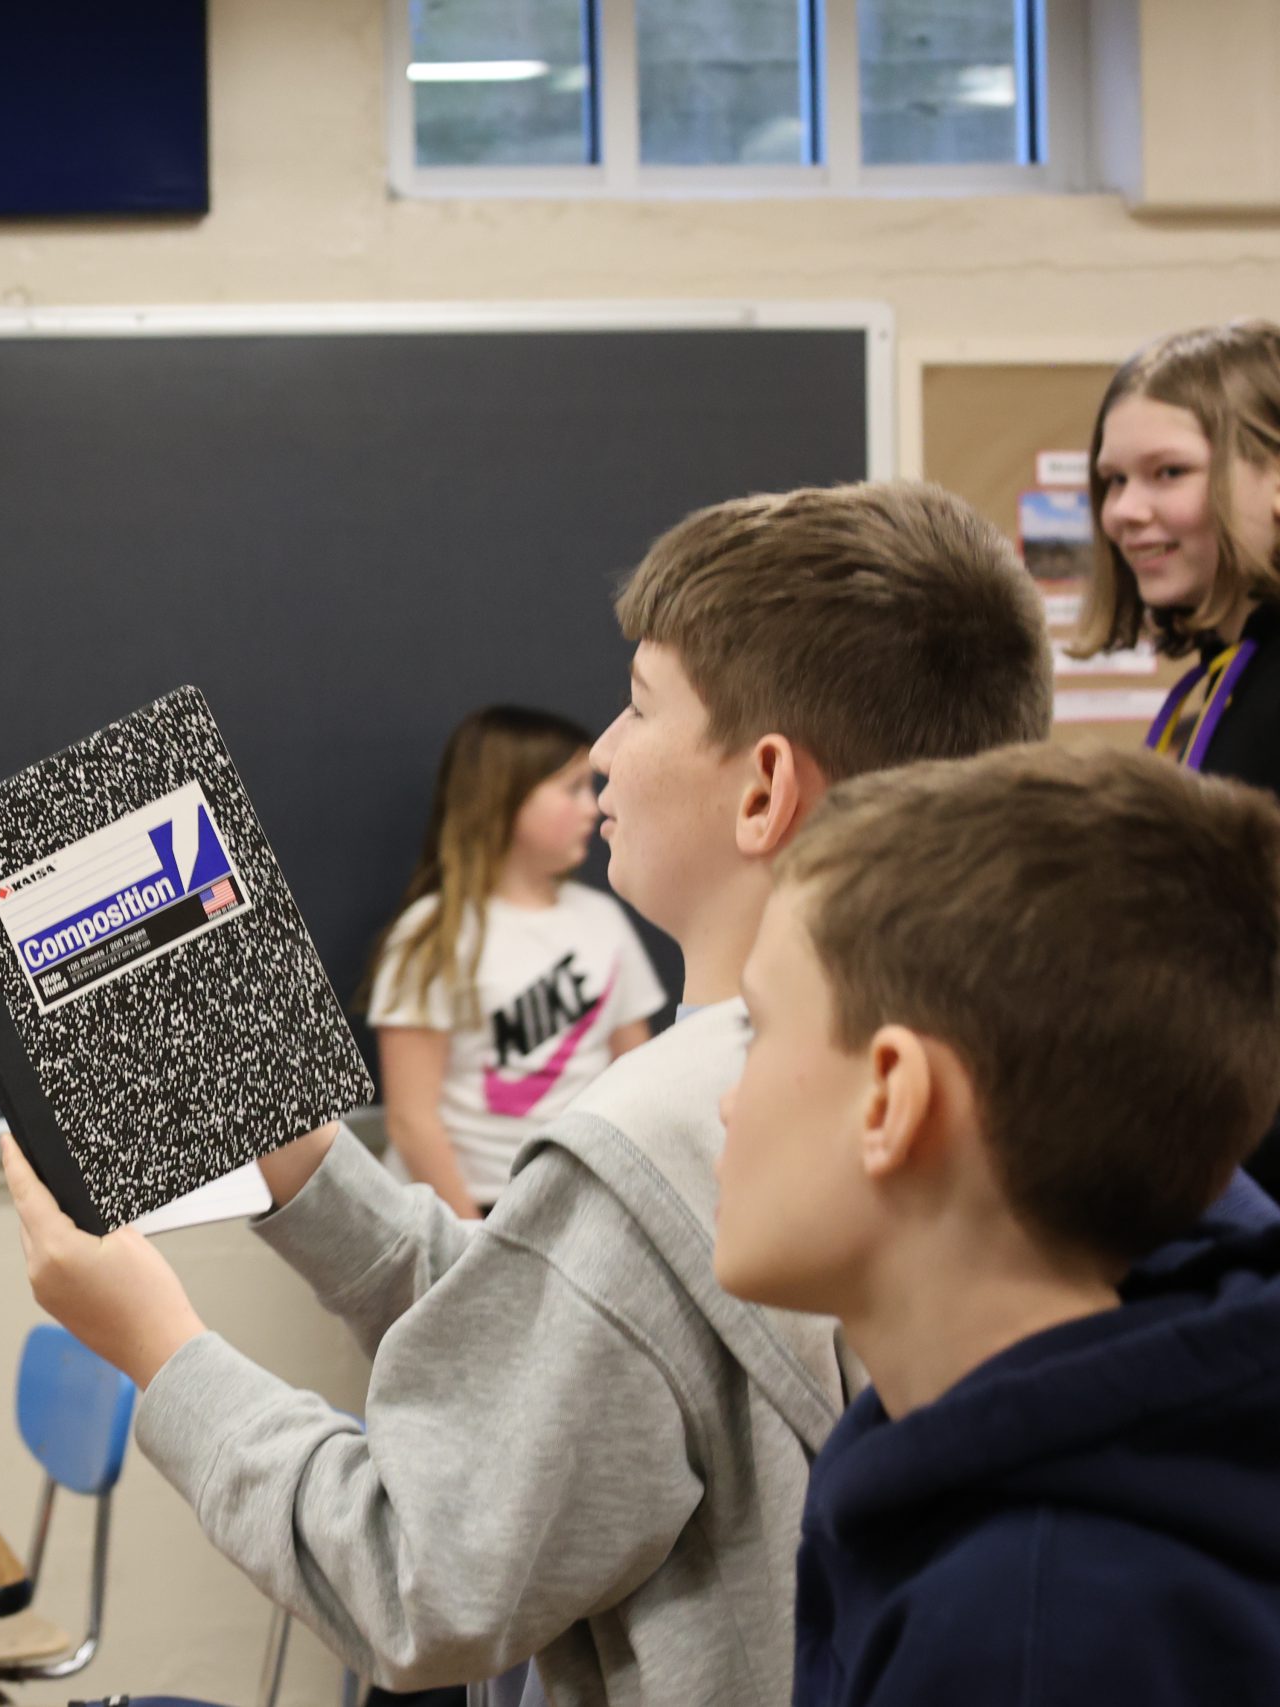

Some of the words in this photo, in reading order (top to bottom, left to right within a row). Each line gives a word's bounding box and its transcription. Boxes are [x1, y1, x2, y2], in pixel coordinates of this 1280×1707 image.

[11, 864, 57, 892] KAISA
[23, 877, 176, 968] Composition
[67, 961, 80, 973] 100
[80, 949, 105, 966] Sheets
[123, 928, 146, 944] Pages
[39, 971, 61, 988] Wide
[43, 977, 68, 998] Ruled
[493, 953, 599, 1066] NIKE
